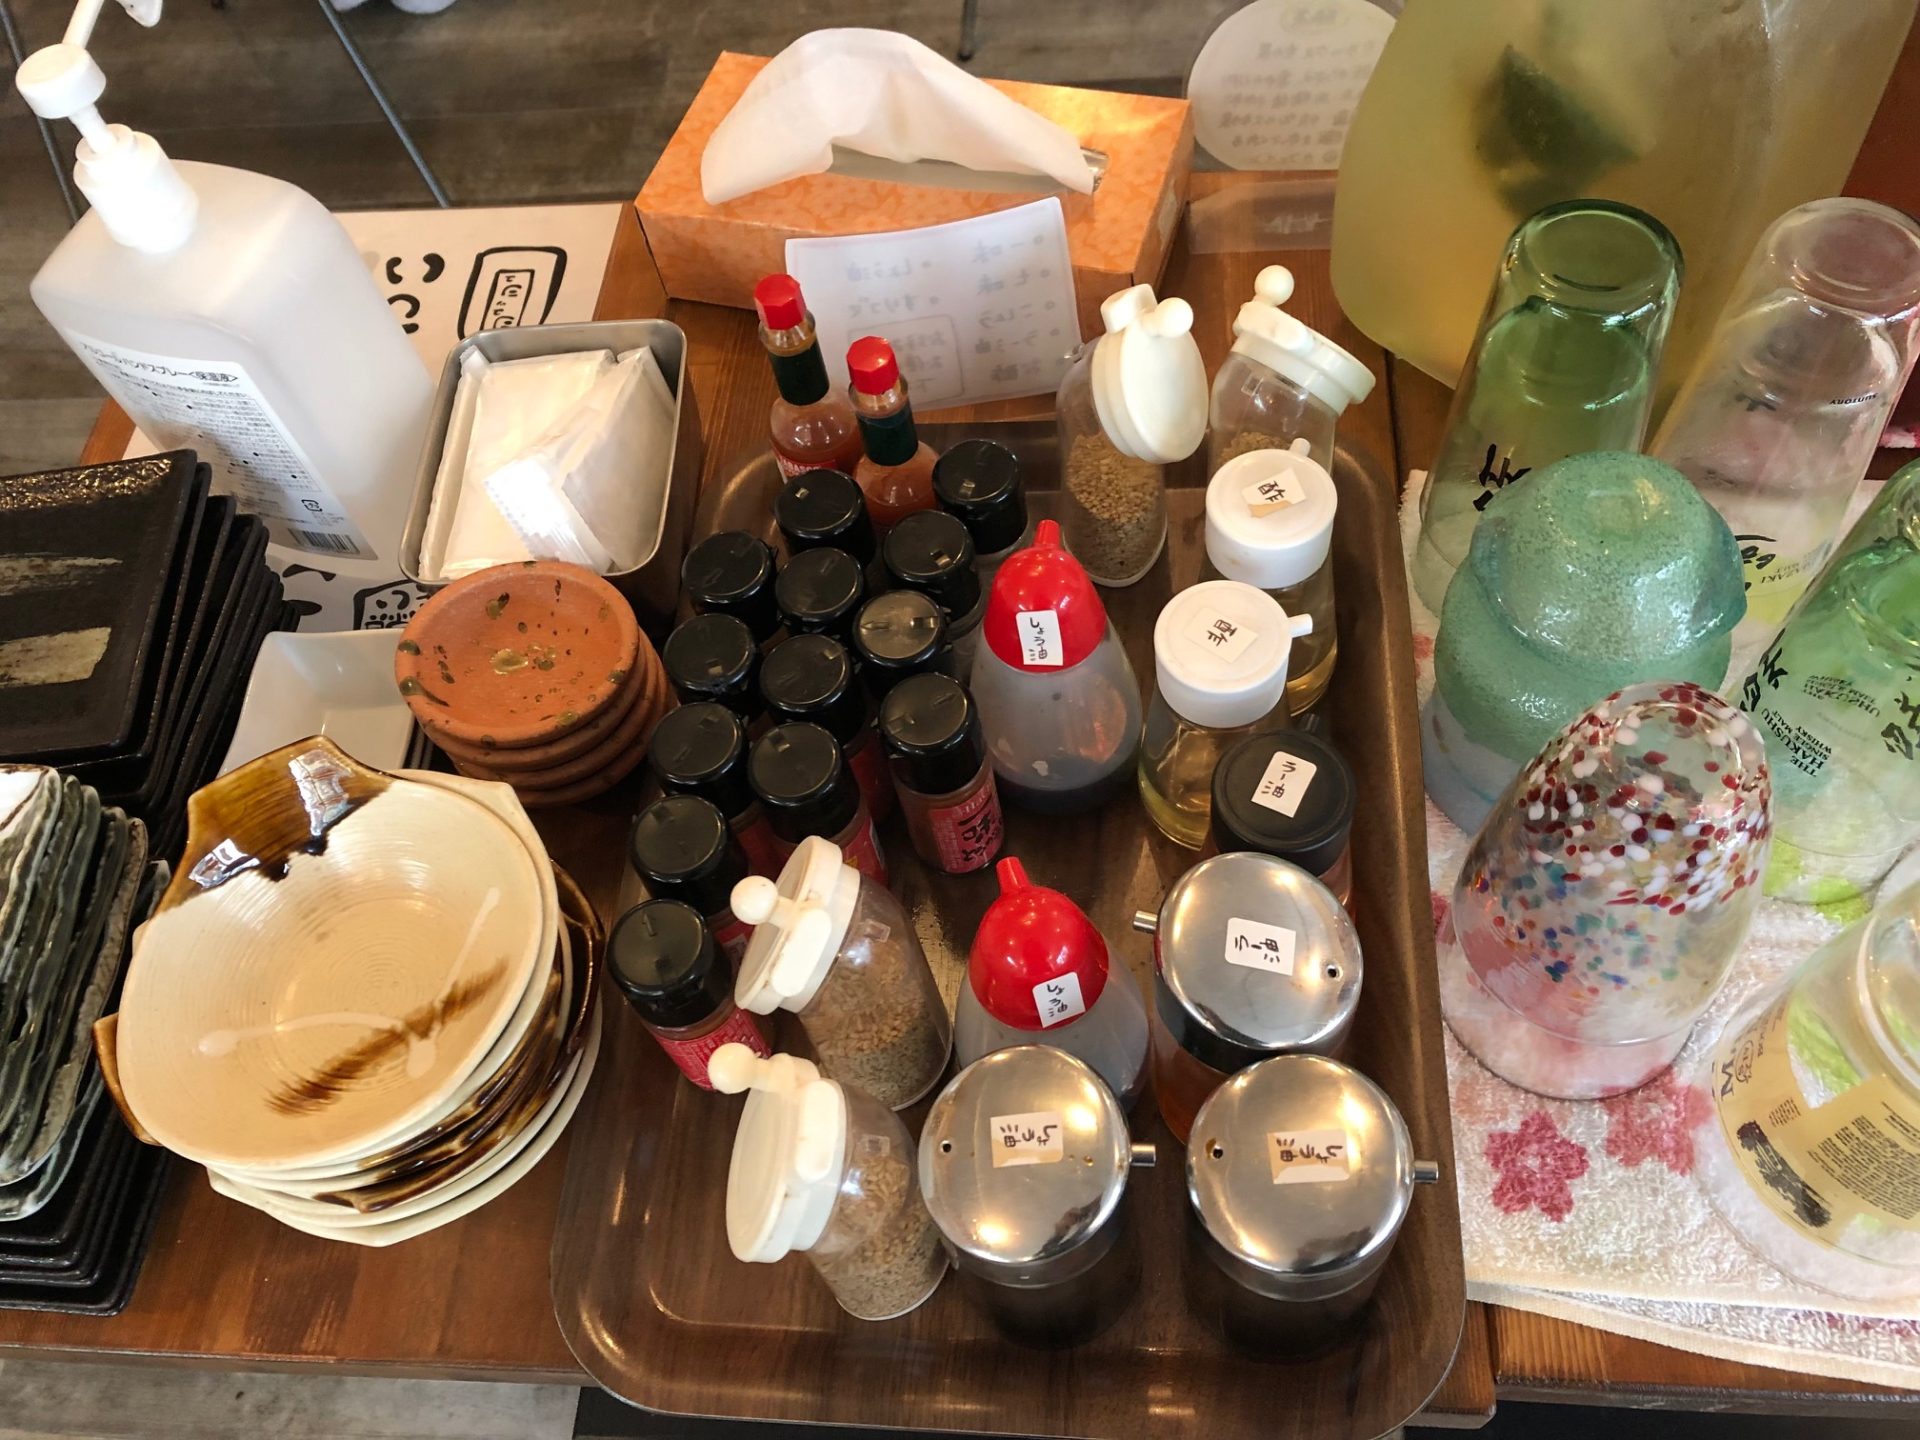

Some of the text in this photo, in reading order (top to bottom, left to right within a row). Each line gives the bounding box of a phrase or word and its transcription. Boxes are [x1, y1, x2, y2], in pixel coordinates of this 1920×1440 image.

[1771, 709, 1794, 733] MALT
[1761, 707, 1825, 770] HAKUSHU
[1795, 725, 1833, 754] WHISKY
[1789, 754, 1818, 778] THE
